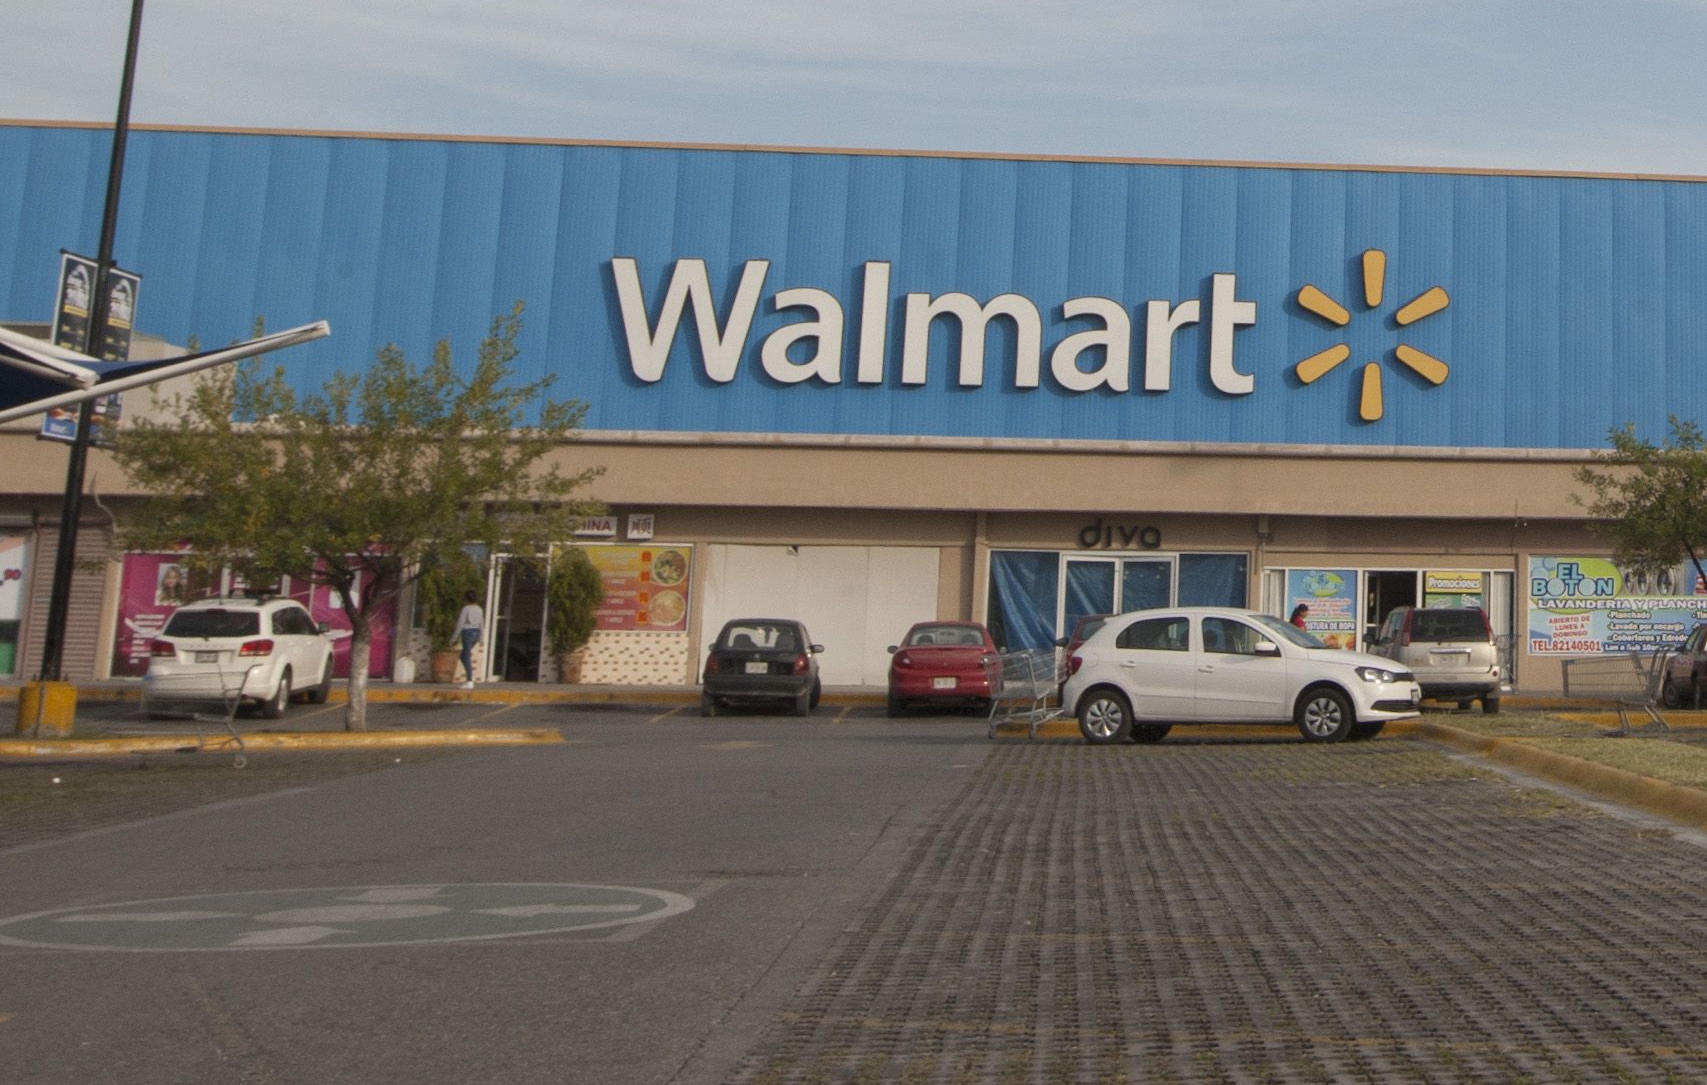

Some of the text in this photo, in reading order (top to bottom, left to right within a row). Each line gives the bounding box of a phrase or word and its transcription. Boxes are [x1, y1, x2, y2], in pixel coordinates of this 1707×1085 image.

[611, 256, 1257, 394] Walmart
[1079, 518, 1162, 549] diva
[1557, 563, 1584, 580] EL
[1428, 576, 1481, 589] Promociones
[1532, 578, 1615, 597] BOTON
[1538, 599, 1632, 609] LAVANDERIA
[1635, 599, 1646, 609] Y
